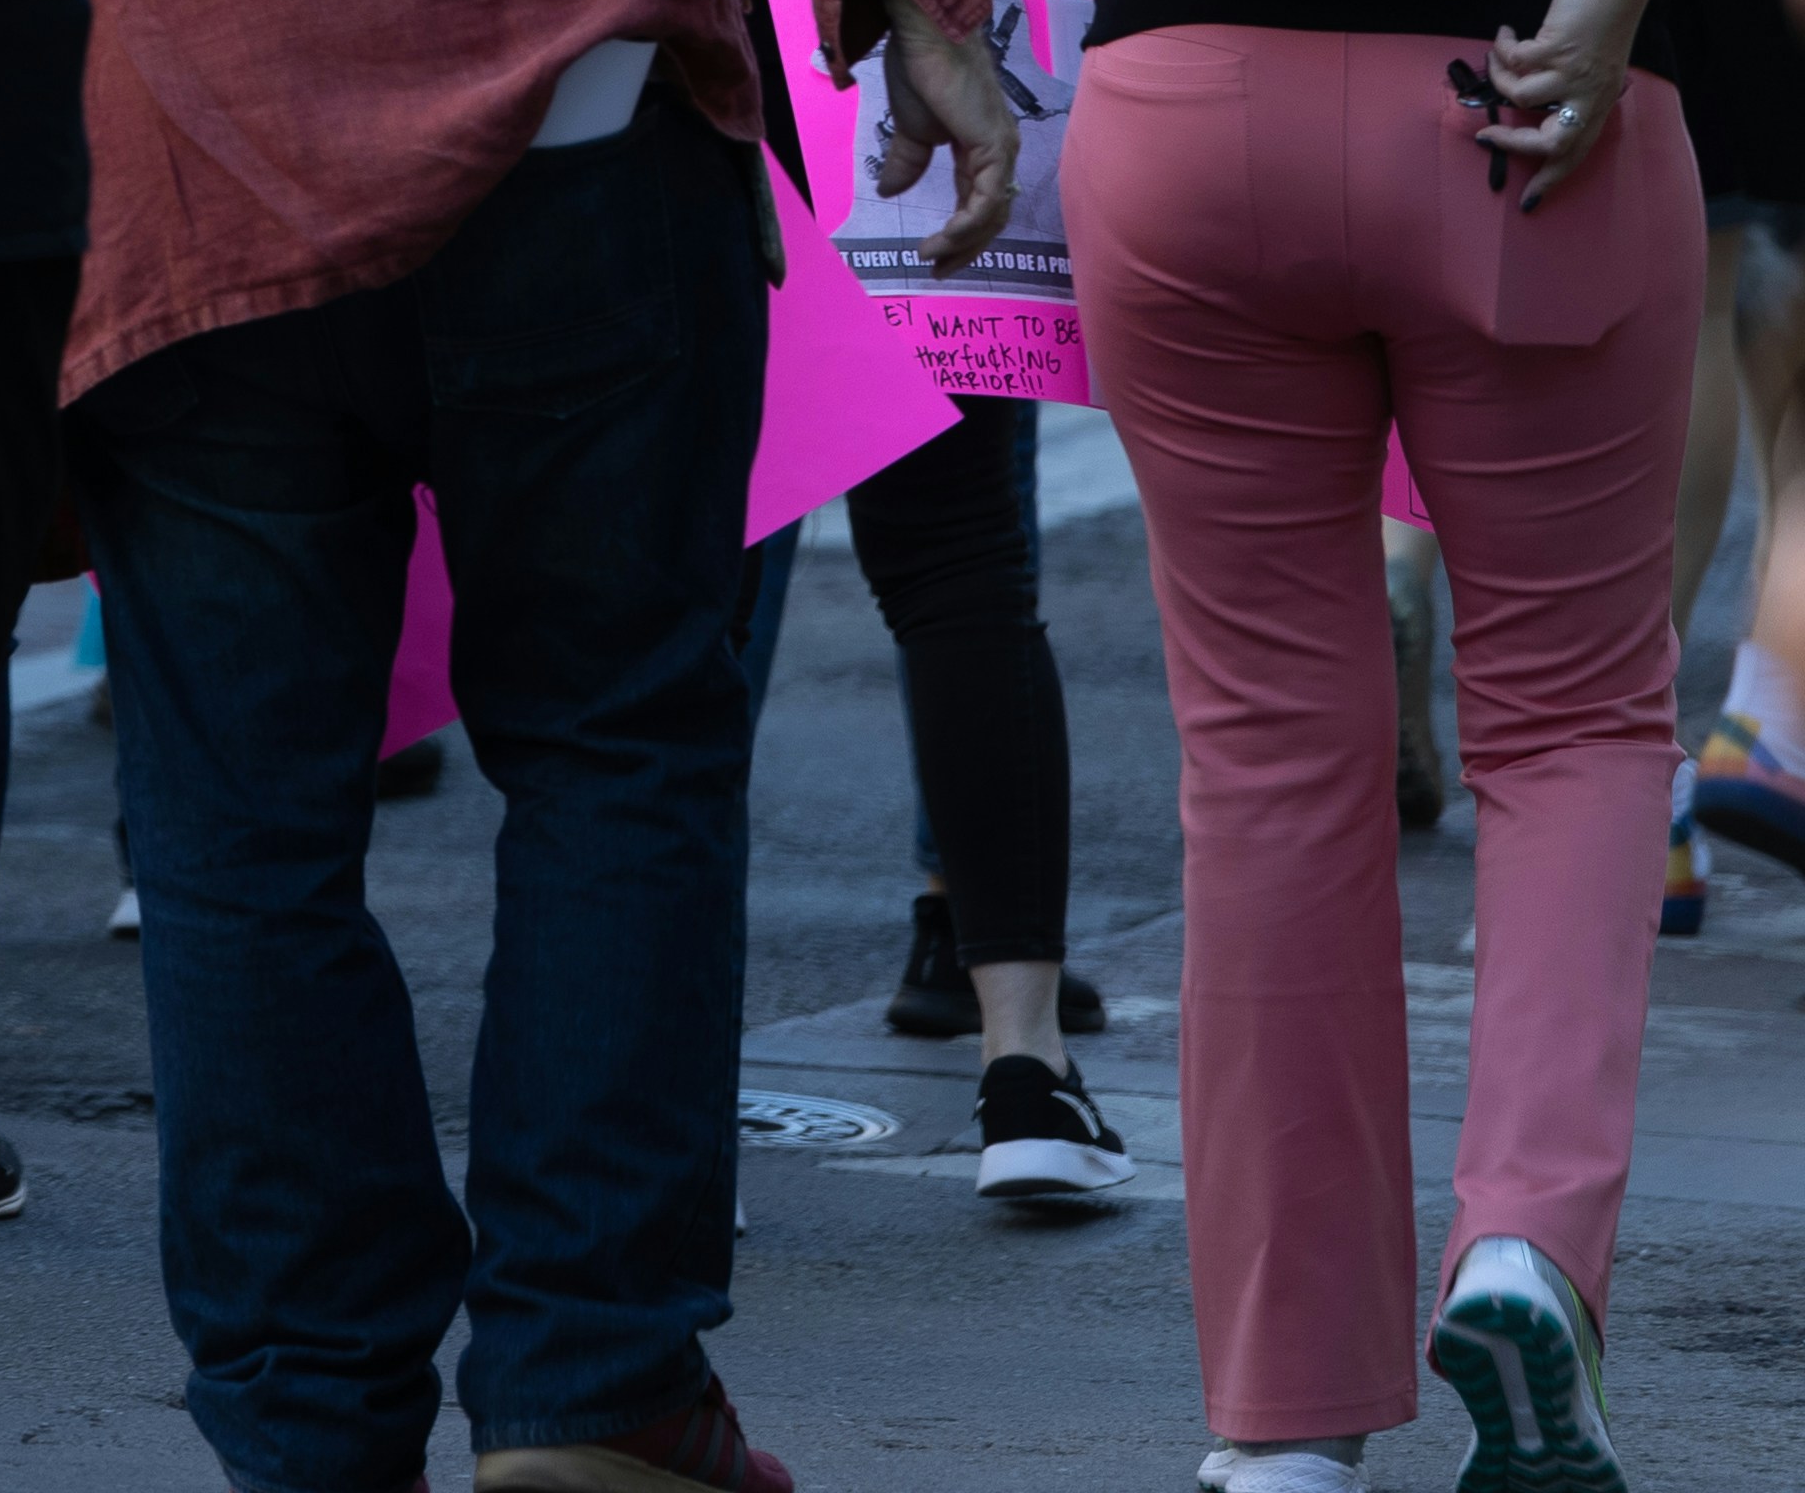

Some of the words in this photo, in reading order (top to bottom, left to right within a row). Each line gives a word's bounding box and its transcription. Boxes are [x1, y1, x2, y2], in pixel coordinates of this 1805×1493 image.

[852, 250, 898, 269] EVERY
[994, 252, 1015, 267] TO
[1017, 253, 1035, 271] BE
[1037, 255, 1048, 274] A
[926, 312, 1003, 339] WANT
[1014, 315, 1045, 339] TO
[1053, 317, 1081, 345] BE
